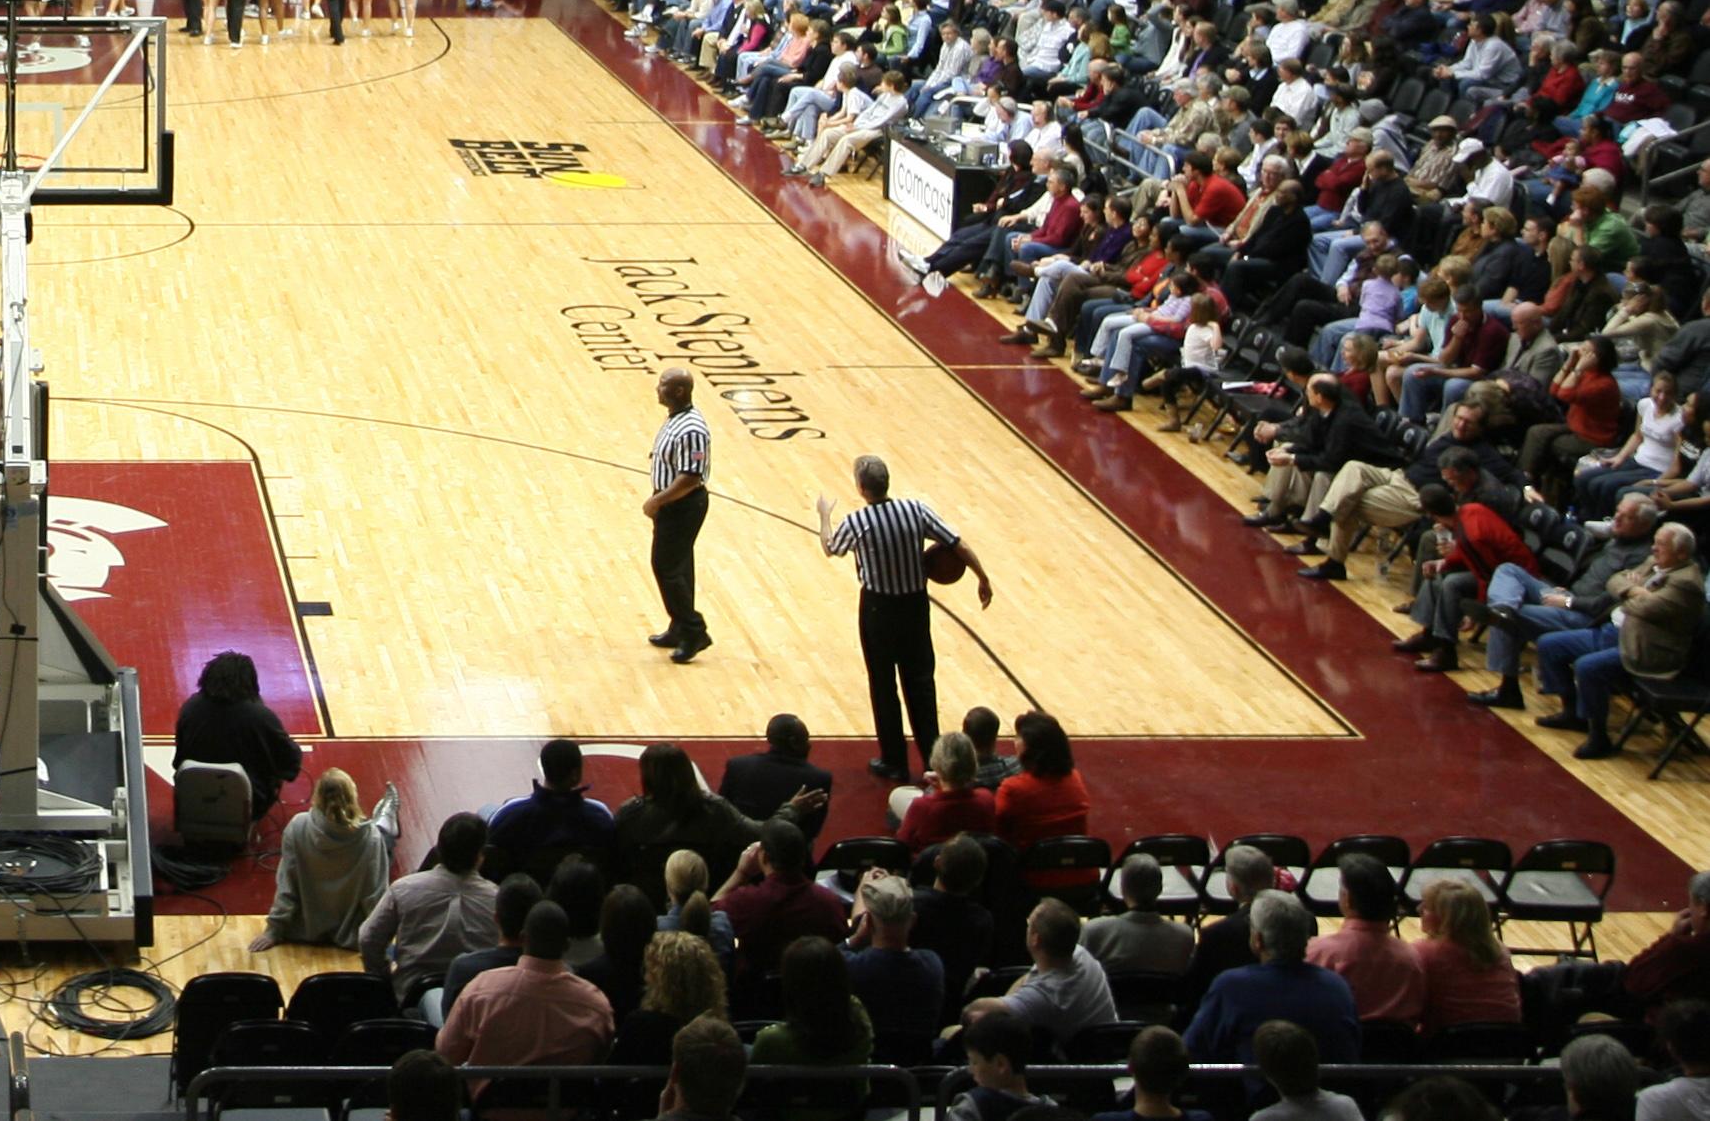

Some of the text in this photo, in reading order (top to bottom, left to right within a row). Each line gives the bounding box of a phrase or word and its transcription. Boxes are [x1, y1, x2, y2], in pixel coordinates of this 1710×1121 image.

[448, 138, 544, 179] BELT
[516, 141, 591, 174] SUN
[896, 162, 952, 225] comcast
[560, 304, 658, 375] Center
[580, 256, 827, 441] Jack Stephens
